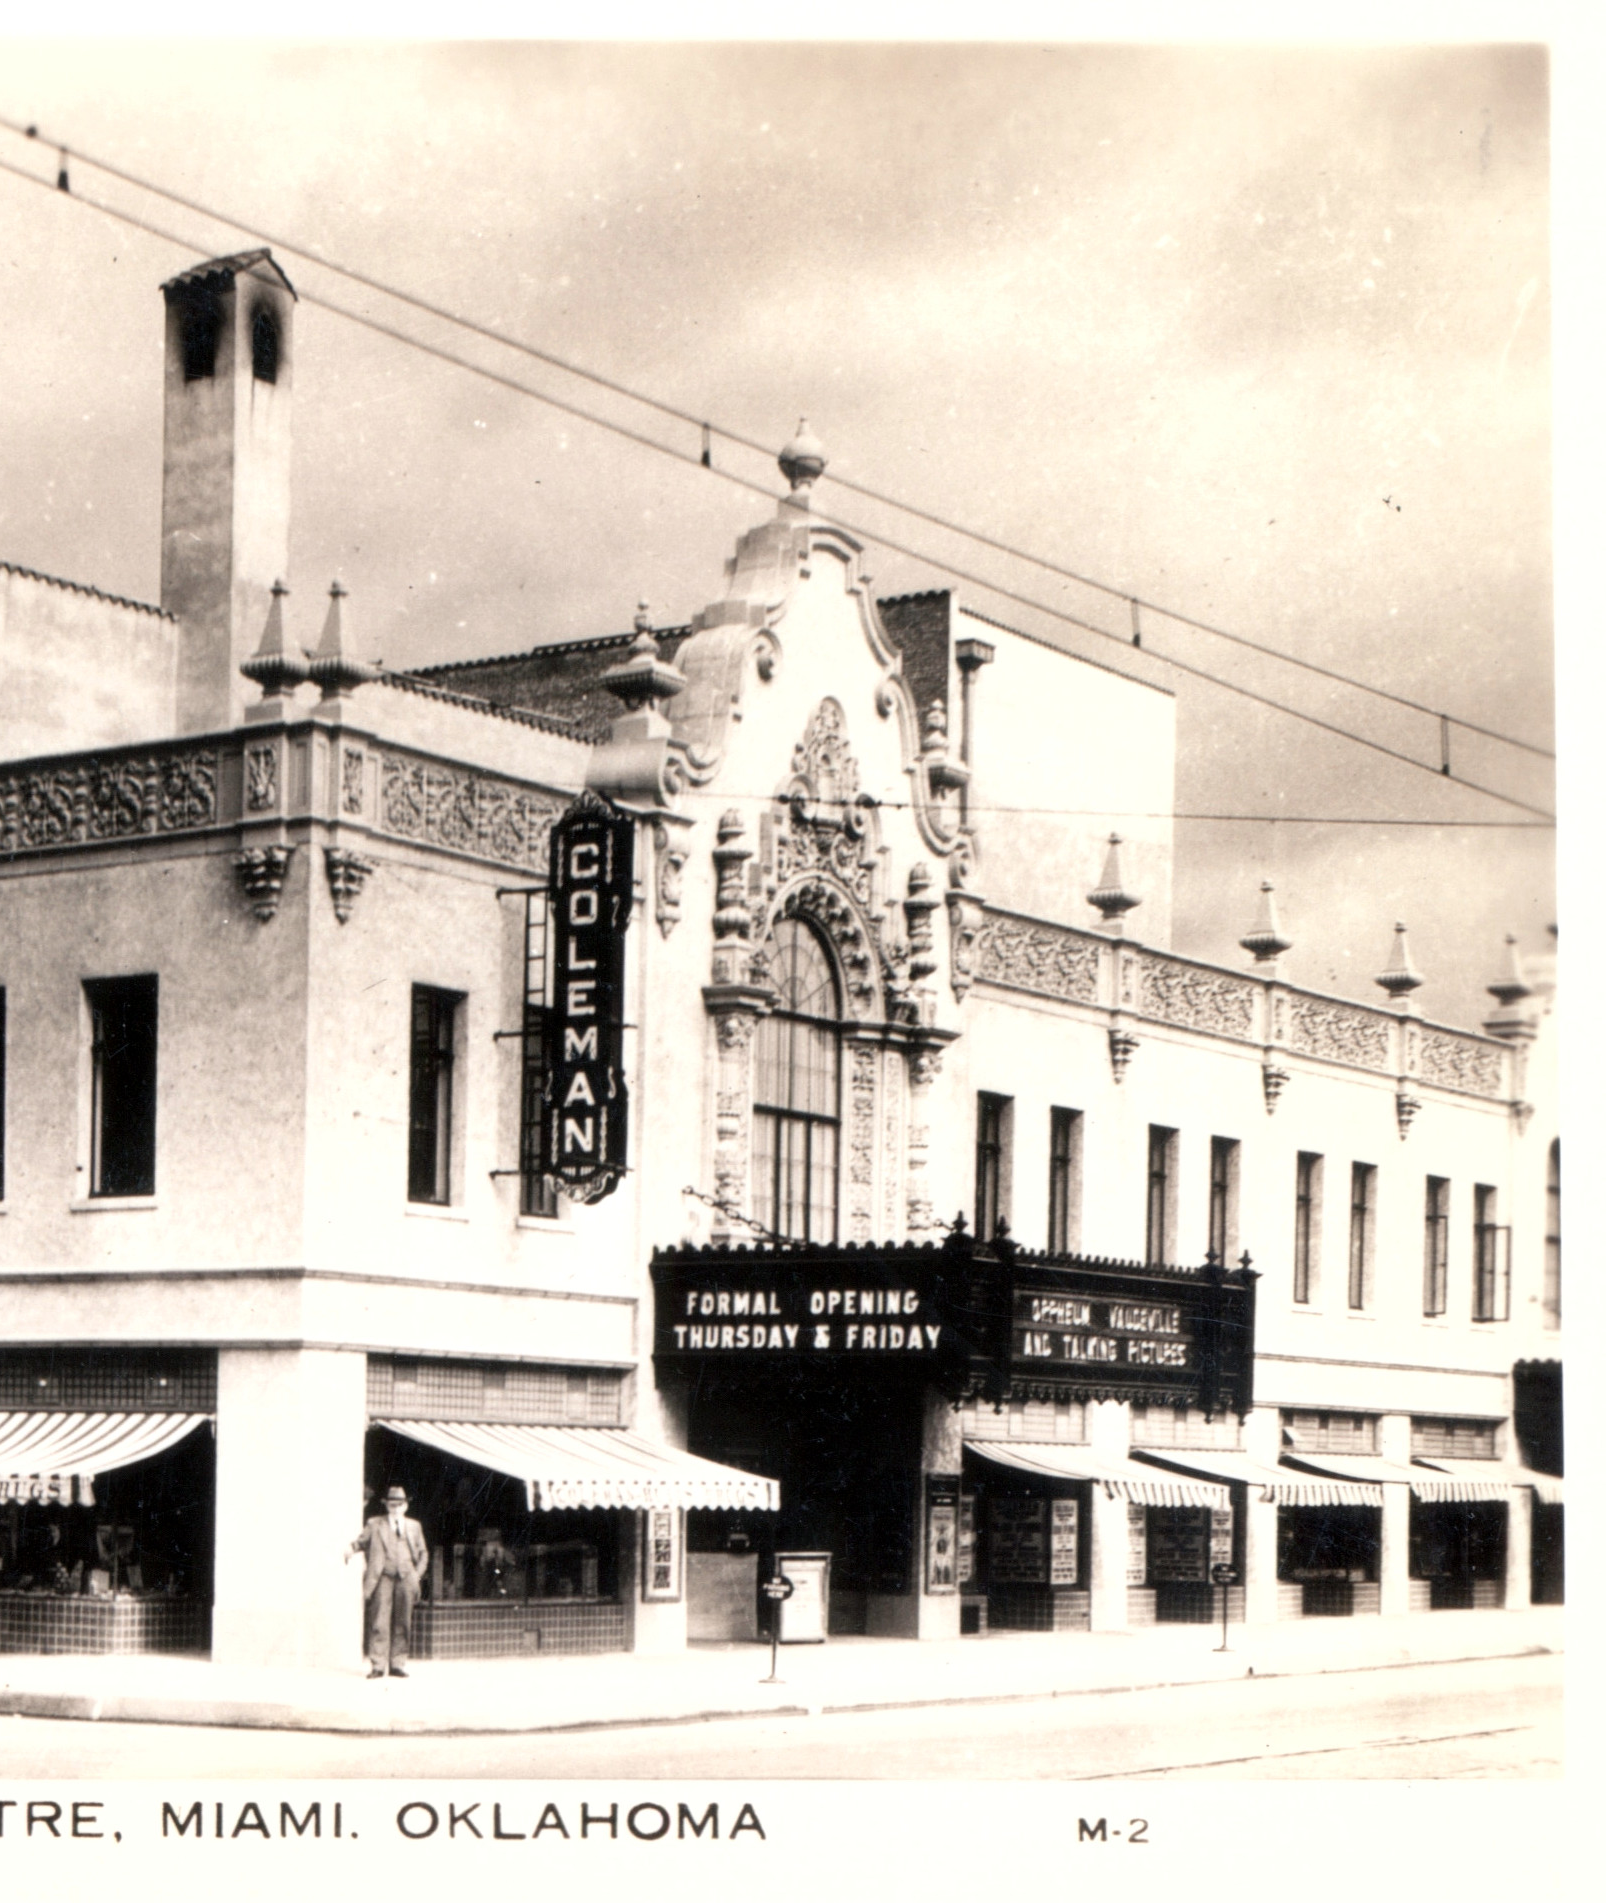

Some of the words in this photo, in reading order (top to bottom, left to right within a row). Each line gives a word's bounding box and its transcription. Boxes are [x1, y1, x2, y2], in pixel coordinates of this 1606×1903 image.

[563, 842, 600, 1154] COLEMAN
[686, 1291, 782, 1316] FORMAL
[809, 1290, 920, 1315] OPENING
[1108, 1303, 1180, 1334] VAUDEVILLE
[673, 1324, 800, 1349] THURSDAY
[812, 1325, 831, 1349] &
[845, 1325, 942, 1350] FRIDAY
[1023, 1331, 1052, 1357] AND
[1062, 1333, 1118, 1361] TALKING
[1127, 1340, 1187, 1367] PICTURES
